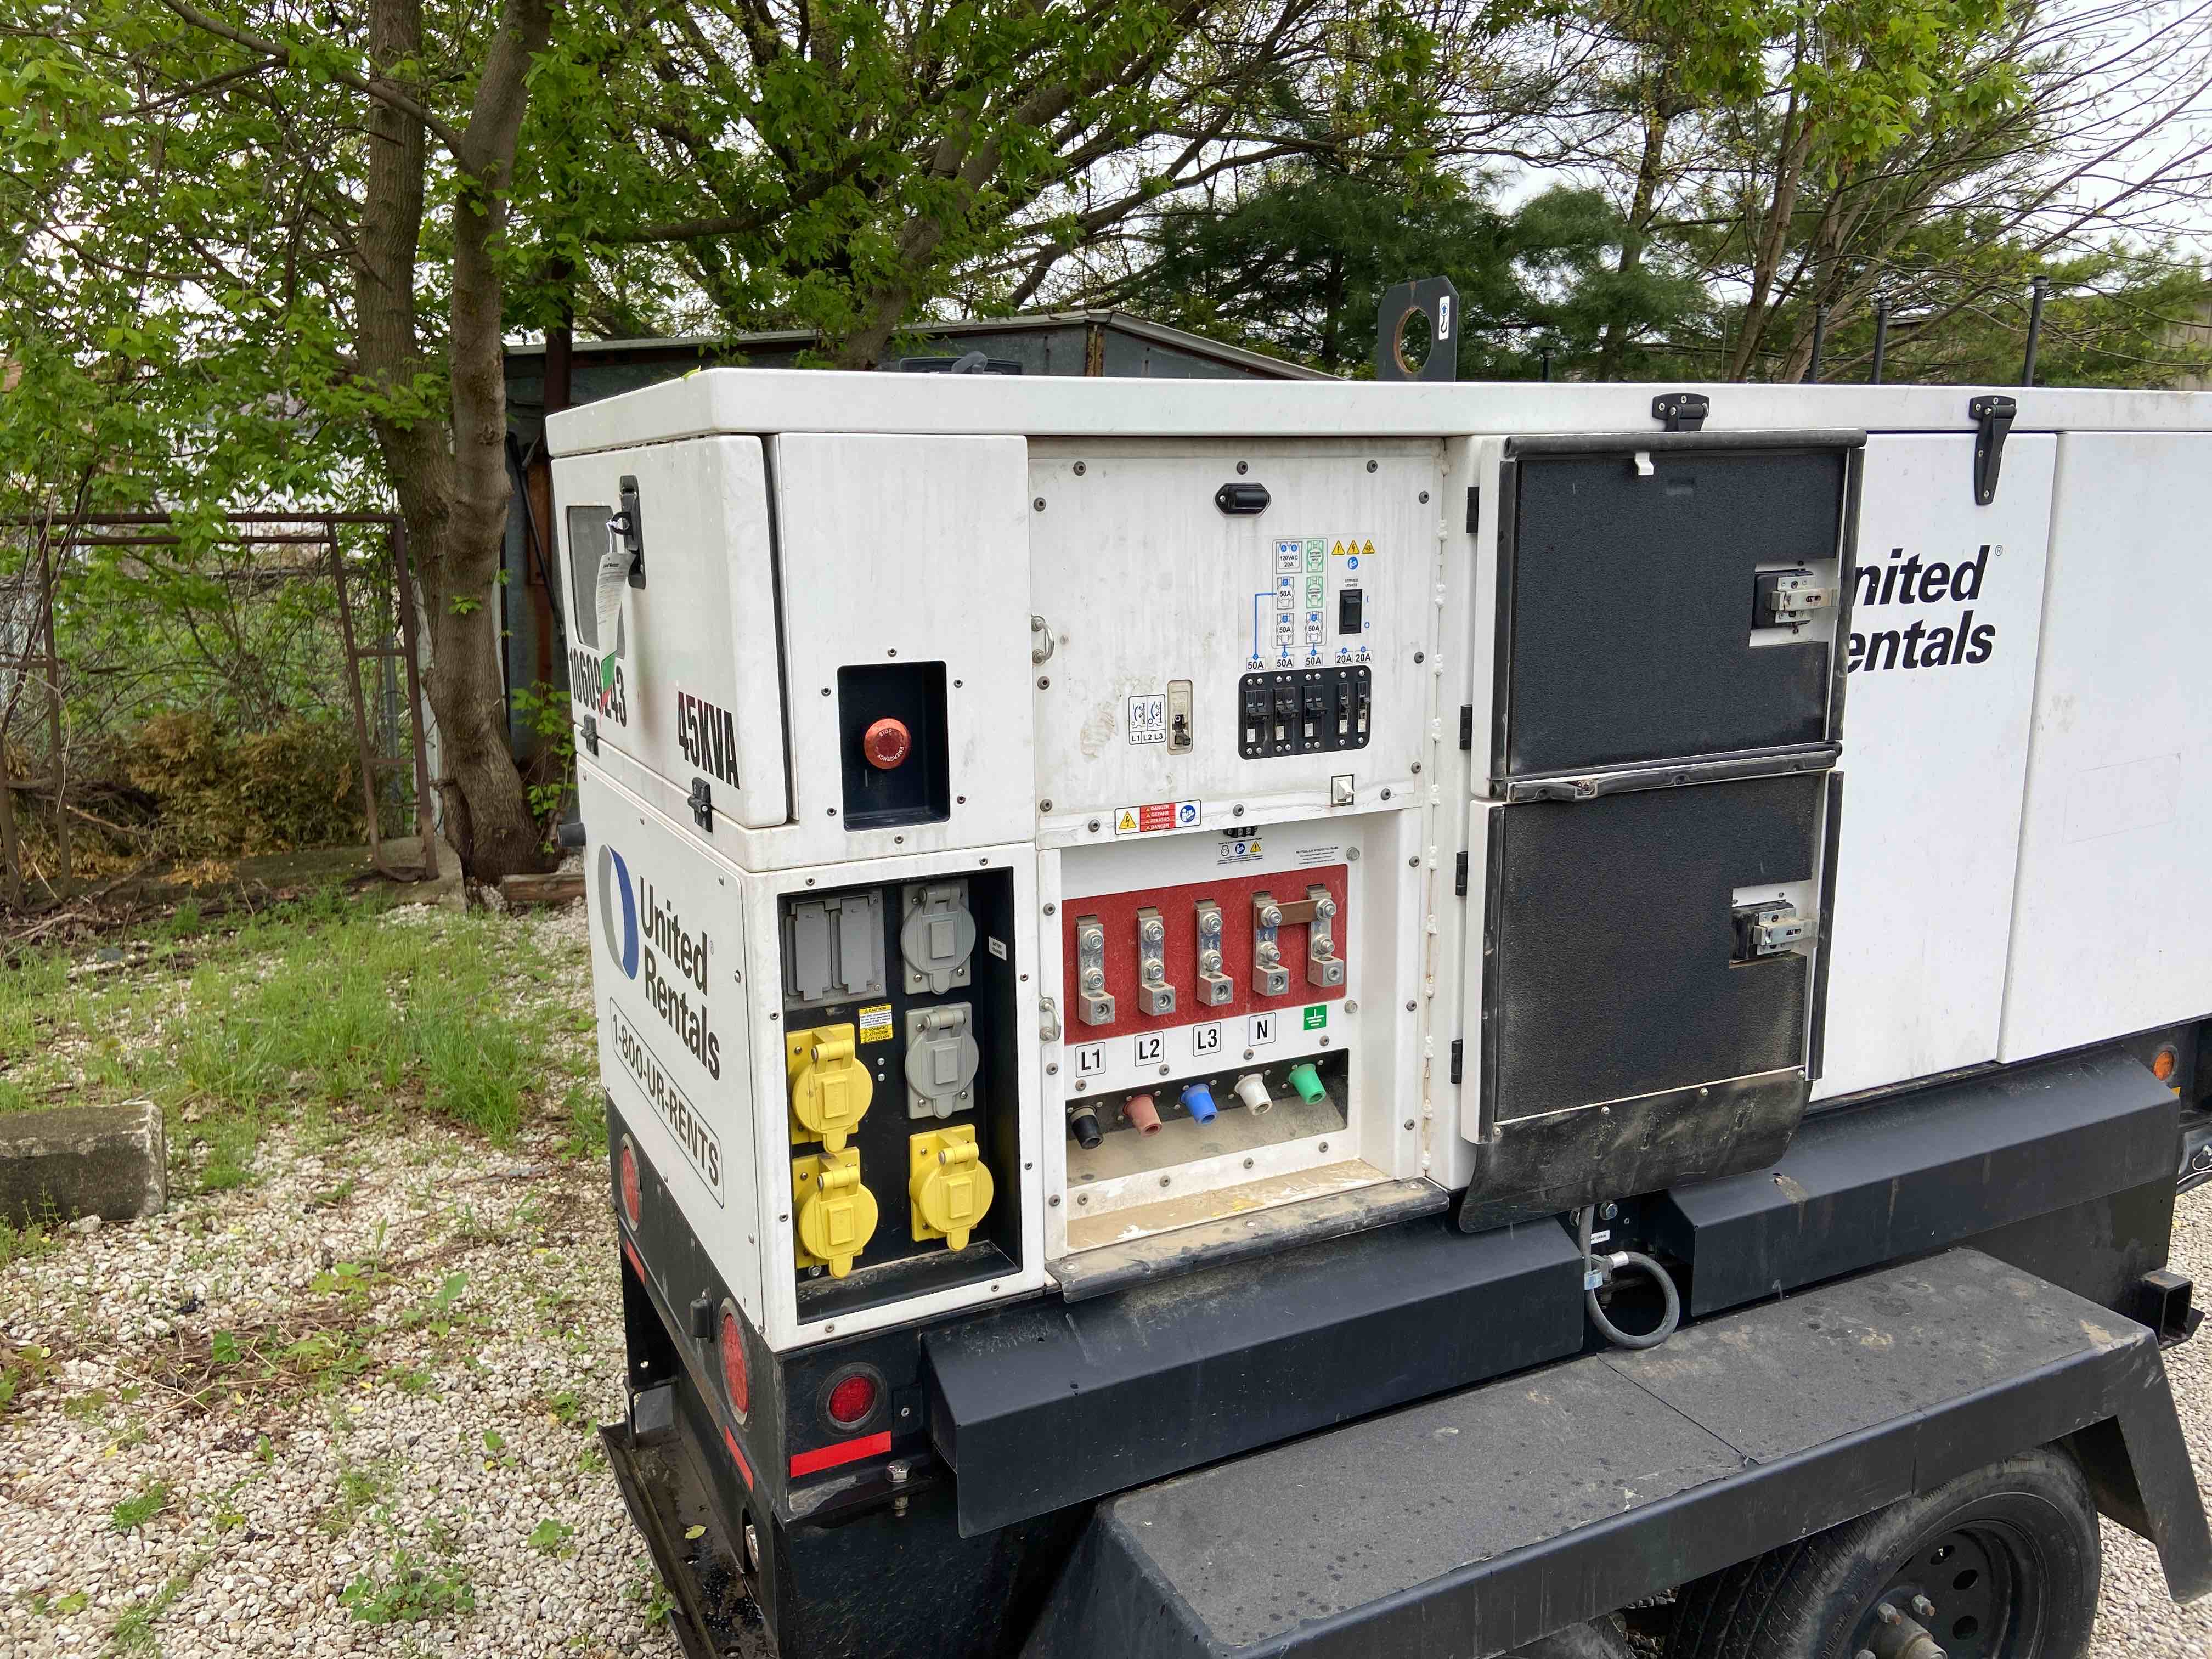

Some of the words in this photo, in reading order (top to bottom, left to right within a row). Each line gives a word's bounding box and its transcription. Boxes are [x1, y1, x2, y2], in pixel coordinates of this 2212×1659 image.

[1853, 545, 1991, 606] nited
[1847, 610, 1996, 674] entals
[1248, 661, 1264, 669] 50A
[1277, 658, 1293, 667] 50A
[1306, 657, 1321, 665] 50A
[1336, 654, 1352, 663] 20A
[1356, 653, 1371, 662] 20A
[569, 647, 627, 727] 1060943
[678, 691, 740, 790] 45KVA
[879, 729, 892, 737] STOP
[878, 746, 905, 762] EMERGENCY
[640, 876, 707, 996] United
[645, 944, 720, 1080] Rentals
[1197, 1029, 1217, 1050] L3
[1257, 1019, 1268, 1040] N
[1081, 1048, 1100, 1070] L1
[1139, 1039, 1160, 1060] L2
[613, 1014, 719, 1187] 1-800-UR-RENTS
